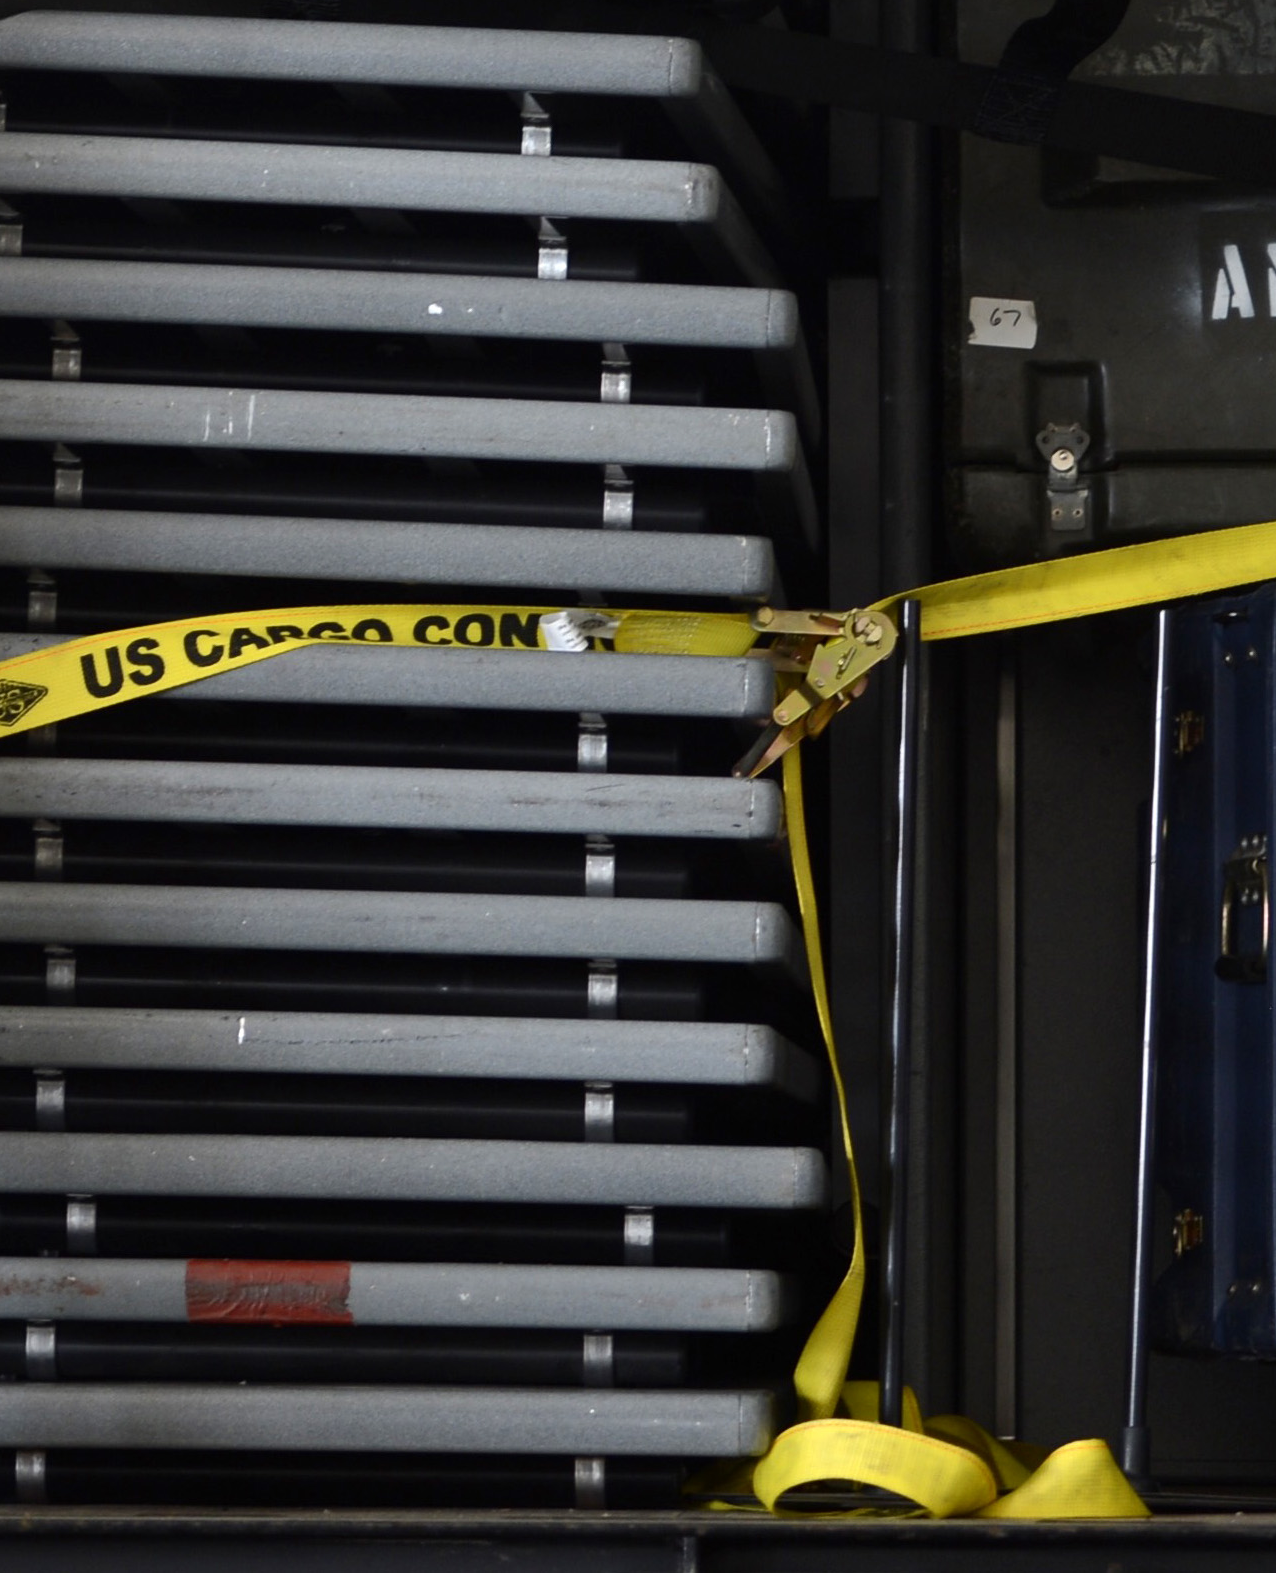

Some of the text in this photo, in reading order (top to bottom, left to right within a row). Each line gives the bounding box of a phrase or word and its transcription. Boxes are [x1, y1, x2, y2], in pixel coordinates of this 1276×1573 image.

[989, 307, 1022, 327] 67
[80, 638, 165, 699] US
[183, 618, 394, 668] CARGO
